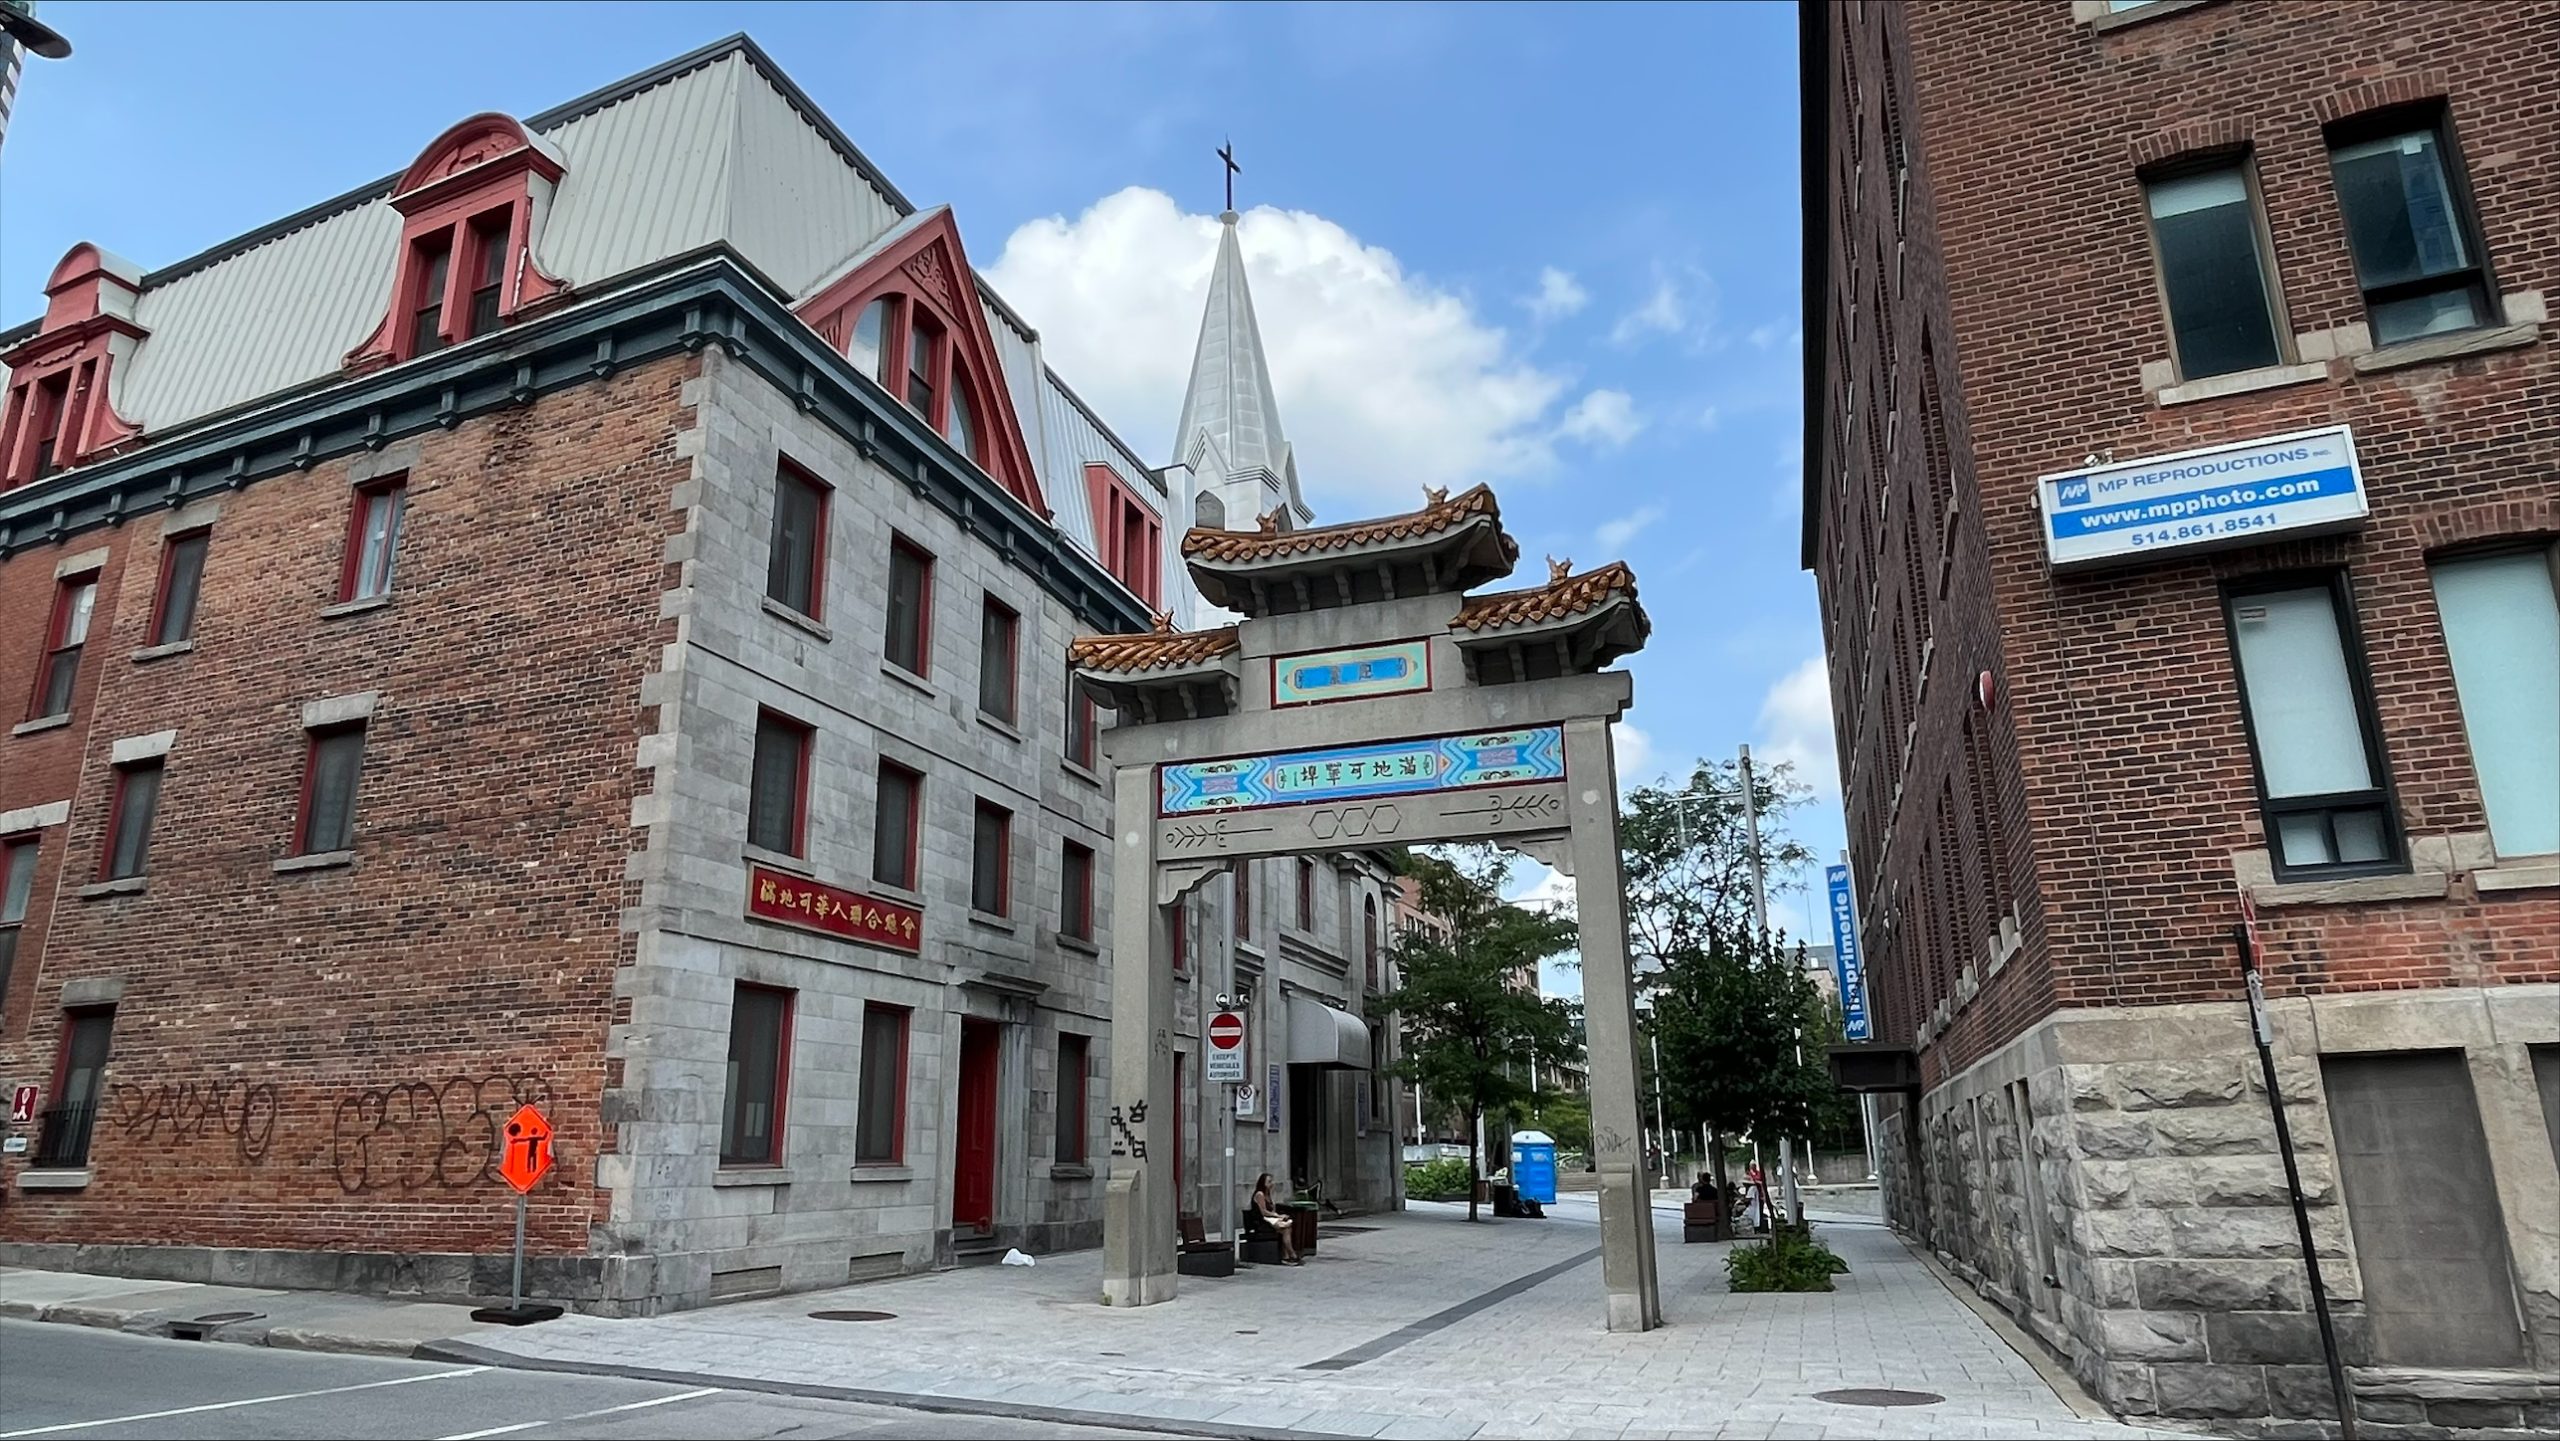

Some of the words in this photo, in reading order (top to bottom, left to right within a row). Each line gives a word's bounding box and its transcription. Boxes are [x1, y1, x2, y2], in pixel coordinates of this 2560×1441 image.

[2097, 478, 2128, 493] MP
[2133, 448, 2309, 487] REPRODUCTIONS
[2061, 483, 2087, 500] MP
[2081, 478, 2320, 529] www.mpphoto.com
[2132, 513, 2277, 546] 514.861.8541
